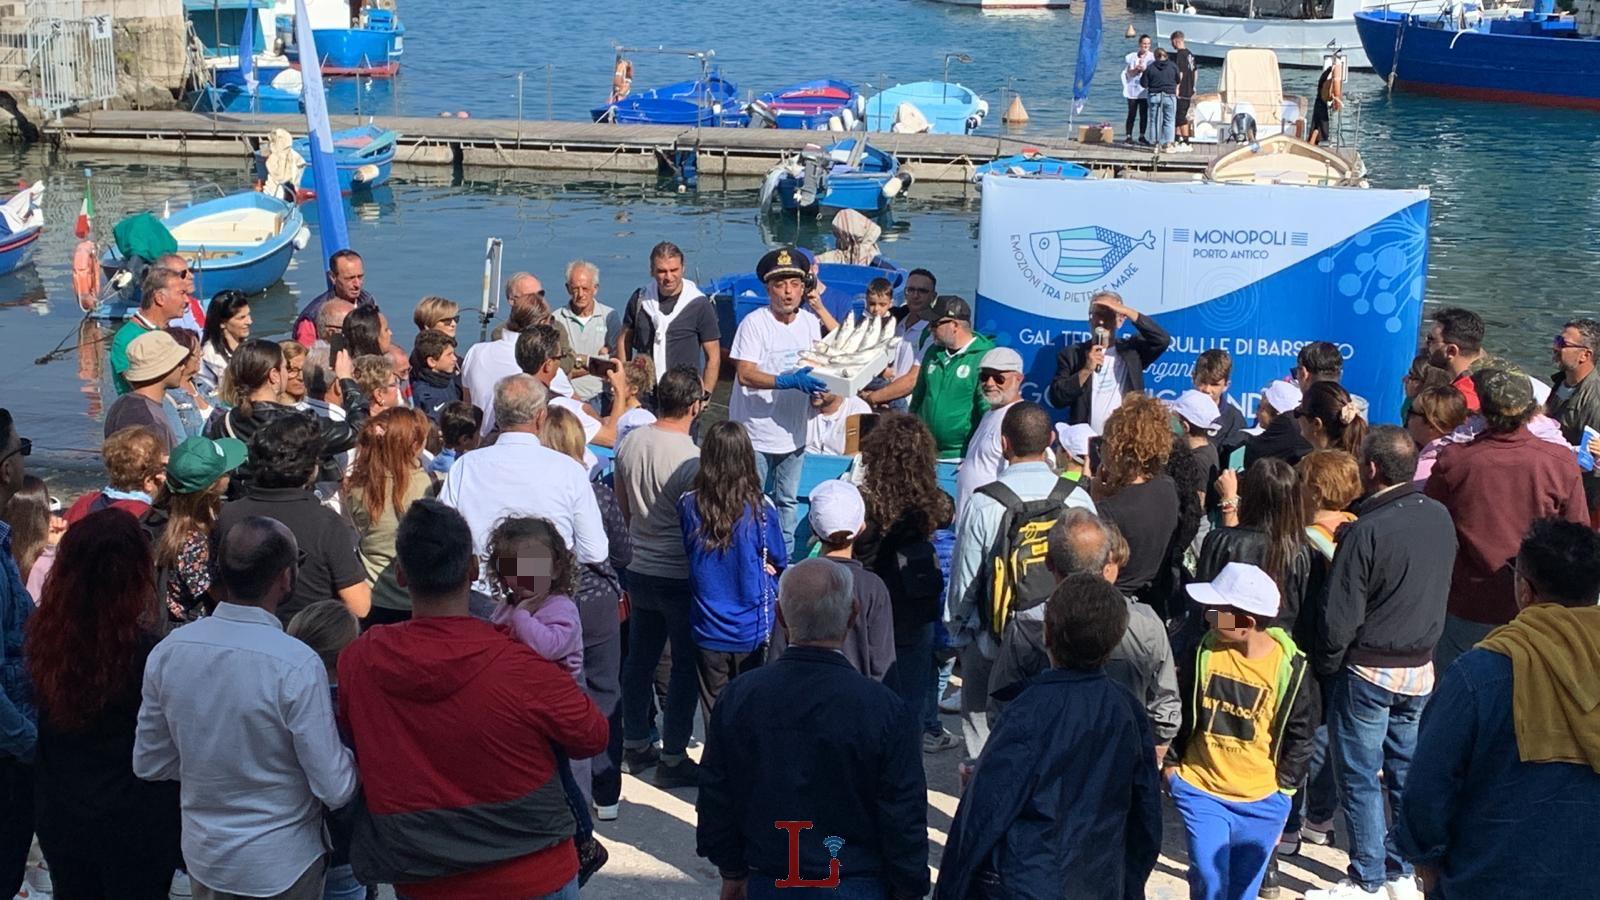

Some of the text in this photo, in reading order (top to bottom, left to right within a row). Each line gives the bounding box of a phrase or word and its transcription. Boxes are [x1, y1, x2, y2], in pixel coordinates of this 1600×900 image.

[1193, 230, 1287, 246] MONOPOLI
[1193, 248, 1270, 260] PORTO ANTICO
[1010, 234, 1041, 288] EMOZIONI
[1041, 283, 1061, 300] TRA
[1110, 262, 1140, 290] MARE
[1019, 328, 1056, 346] GAL
[1236, 338, 1252, 355] DI
